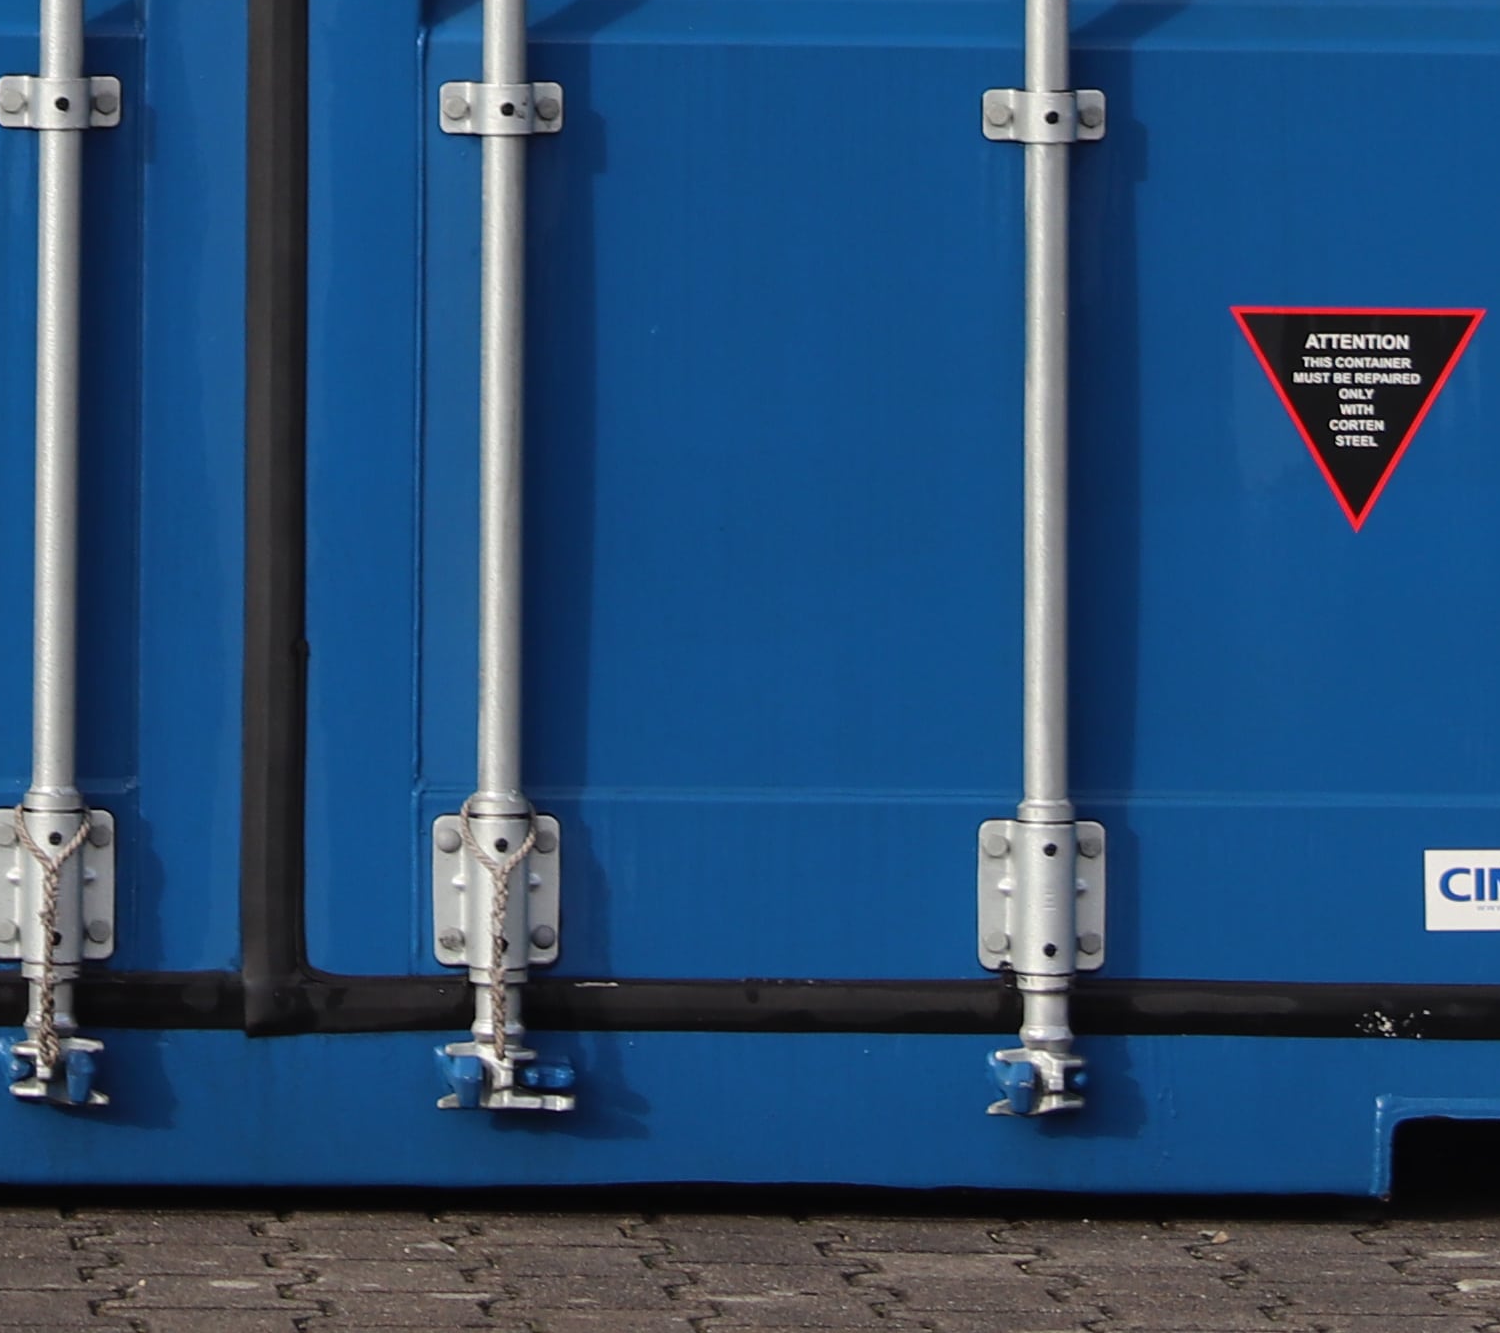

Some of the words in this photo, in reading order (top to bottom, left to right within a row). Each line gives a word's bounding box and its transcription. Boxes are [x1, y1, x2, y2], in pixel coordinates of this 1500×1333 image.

[1305, 333, 1410, 350] ATTENTION
[1302, 356, 1333, 369] THIS
[1334, 356, 1412, 369] CONTAINER
[1293, 371, 1331, 384] MUST
[1333, 372, 1352, 384] BE
[1354, 372, 1421, 385] REPAIRED
[1338, 387, 1375, 400] ONLY
[1339, 403, 1374, 416] WITH
[1329, 419, 1385, 432] CORTEN
[1335, 434, 1379, 447] STEEL
